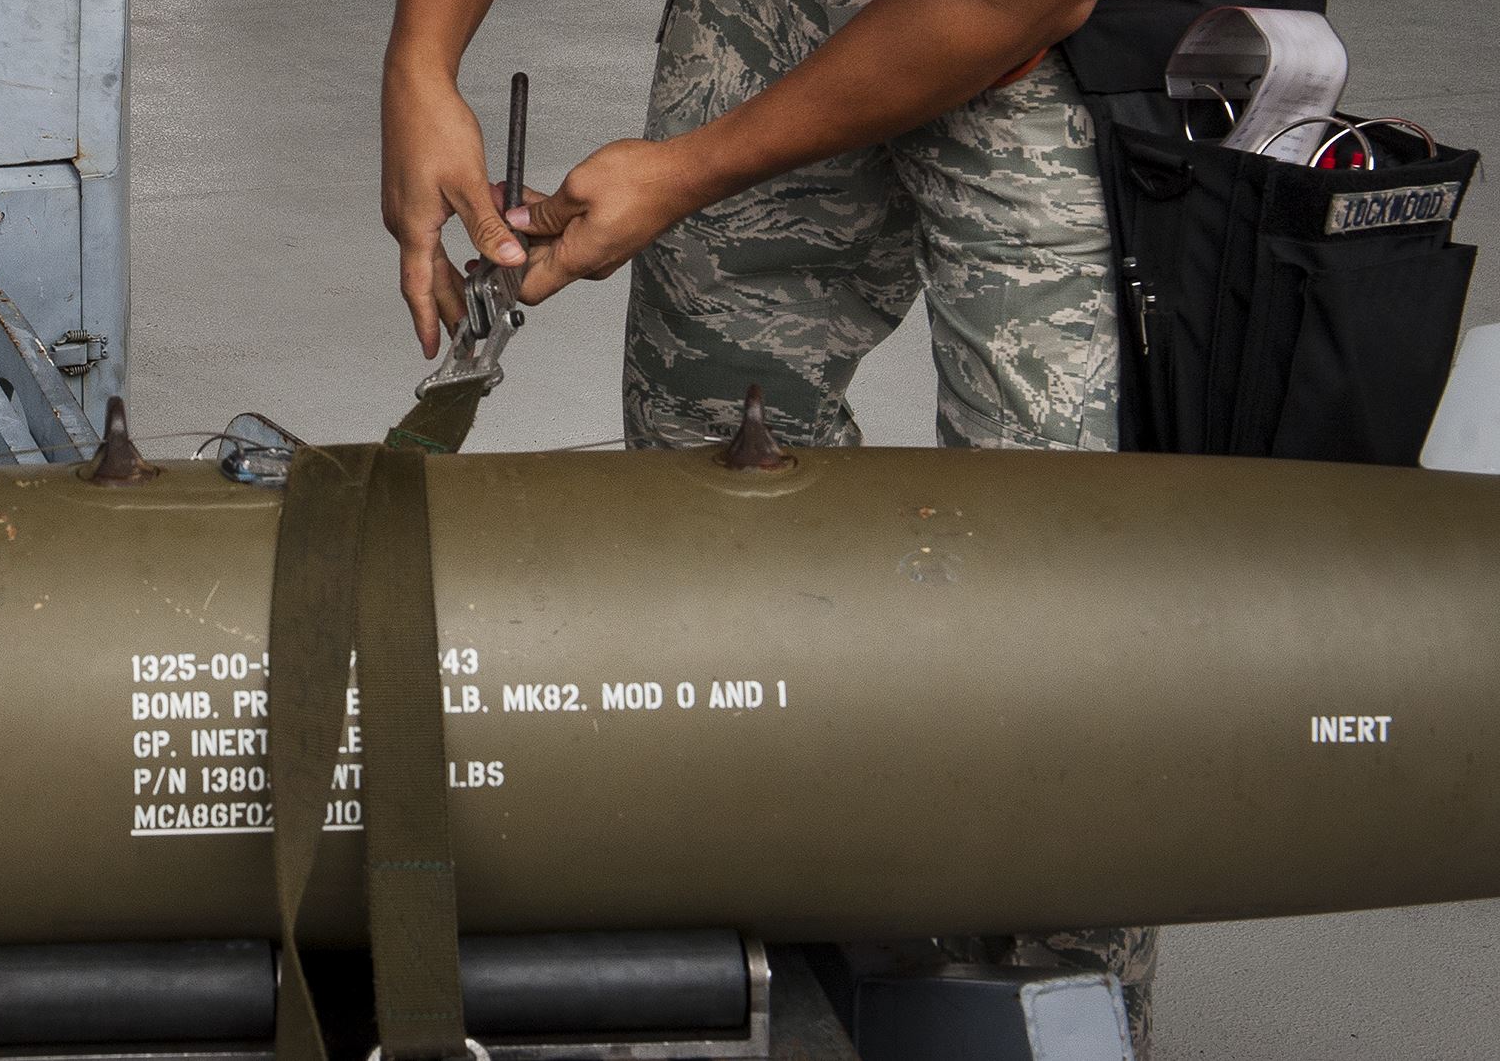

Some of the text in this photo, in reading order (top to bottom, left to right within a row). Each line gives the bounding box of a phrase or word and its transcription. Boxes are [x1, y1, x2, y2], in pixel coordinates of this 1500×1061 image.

[1343, 189, 1444, 229] LOCKWOOD
[132, 691, 219, 721] BOMB.
[443, 686, 489, 714] LB.
[503, 684, 588, 712] MK82.
[602, 682, 663, 710] MOD
[708, 680, 763, 709] AND
[776, 680, 787, 708] 1
[133, 728, 268, 758] GP. INERT
[1311, 715, 1392, 742] INERT
[133, 767, 187, 795] P/N
[201, 766, 272, 794] 1380
[449, 761, 504, 788] LBS
